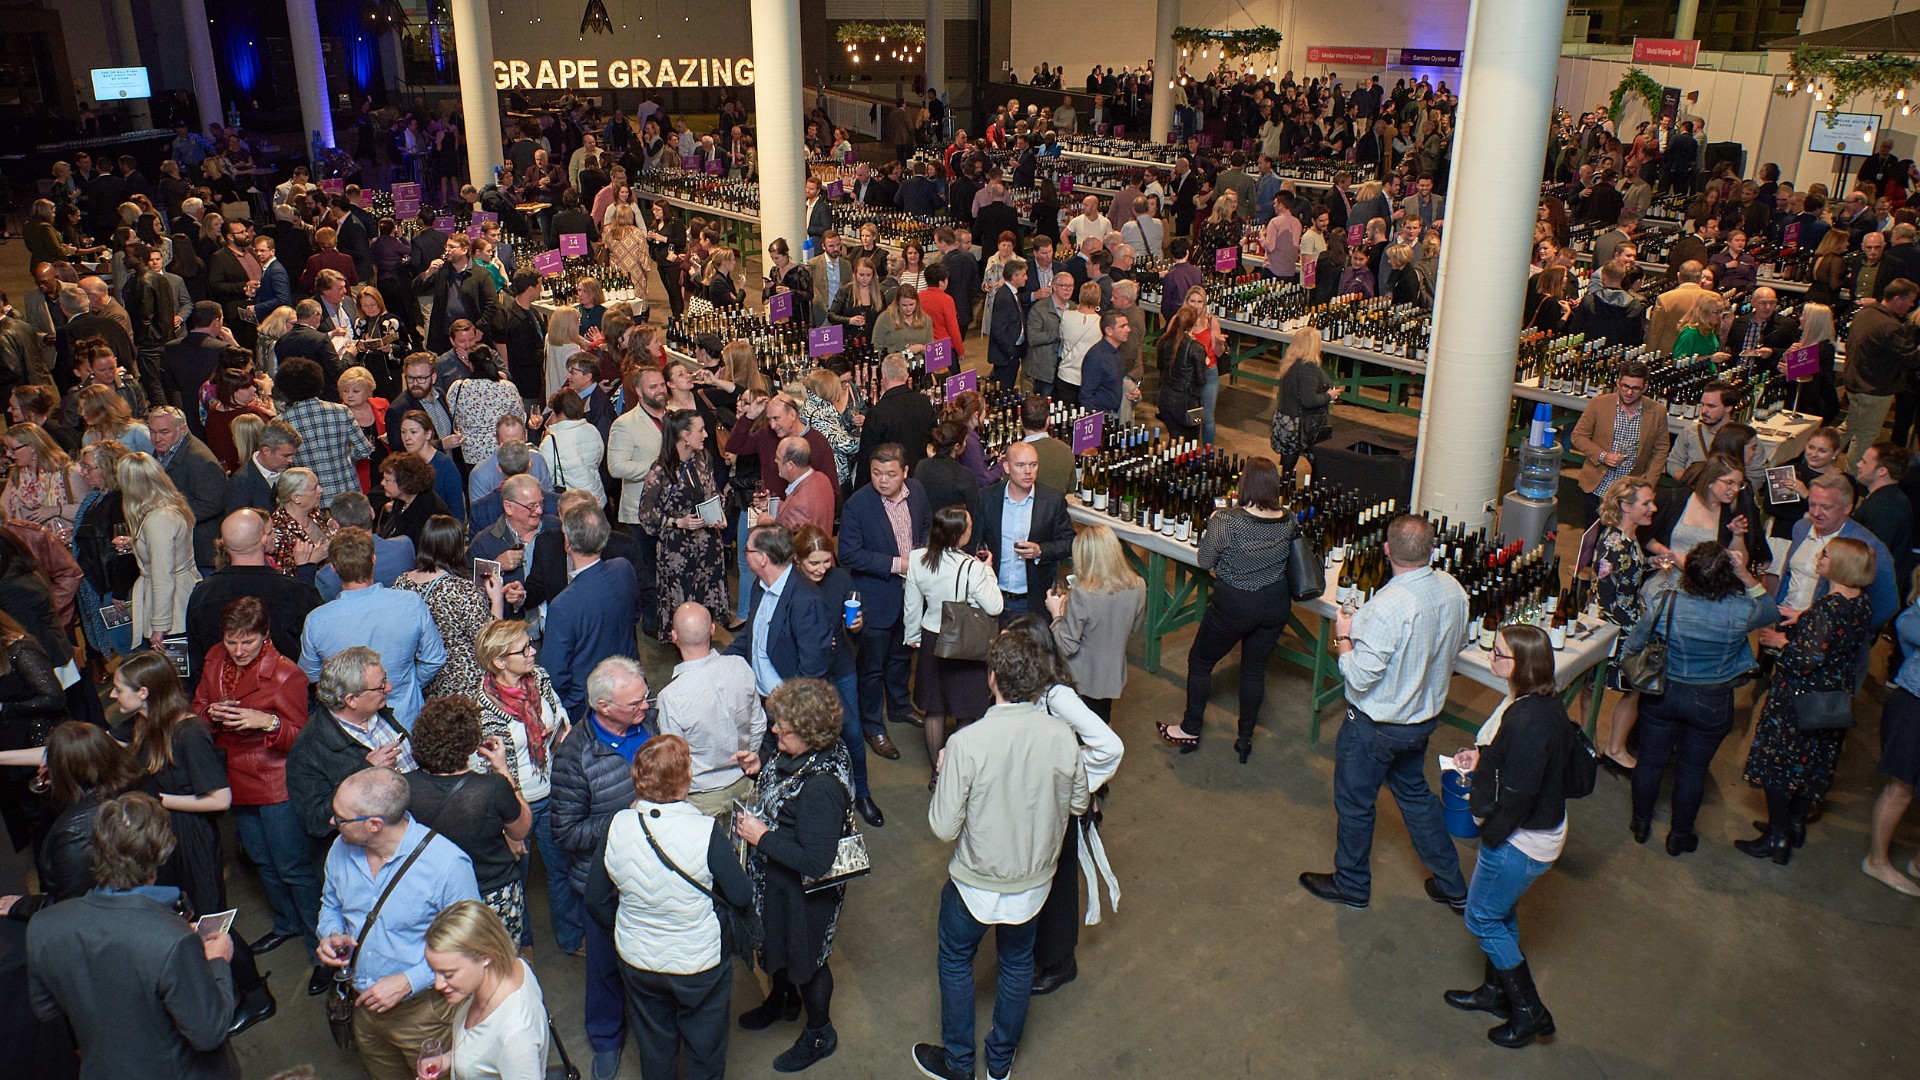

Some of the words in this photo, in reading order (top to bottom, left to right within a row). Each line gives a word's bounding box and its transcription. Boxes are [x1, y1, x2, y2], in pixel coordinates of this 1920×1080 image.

[1431, 55, 1447, 63] Oyster
[493, 59, 599, 90] GRAPE
[608, 58, 755, 88] GRAZING
[545, 256, 550, 264] 7
[777, 299, 785, 308] 13
[823, 333, 830, 342] 8
[935, 346, 943, 356] 12
[1797, 351, 1808, 363] 22
[958, 380, 965, 390] 9
[1084, 423, 1094, 435] 10
